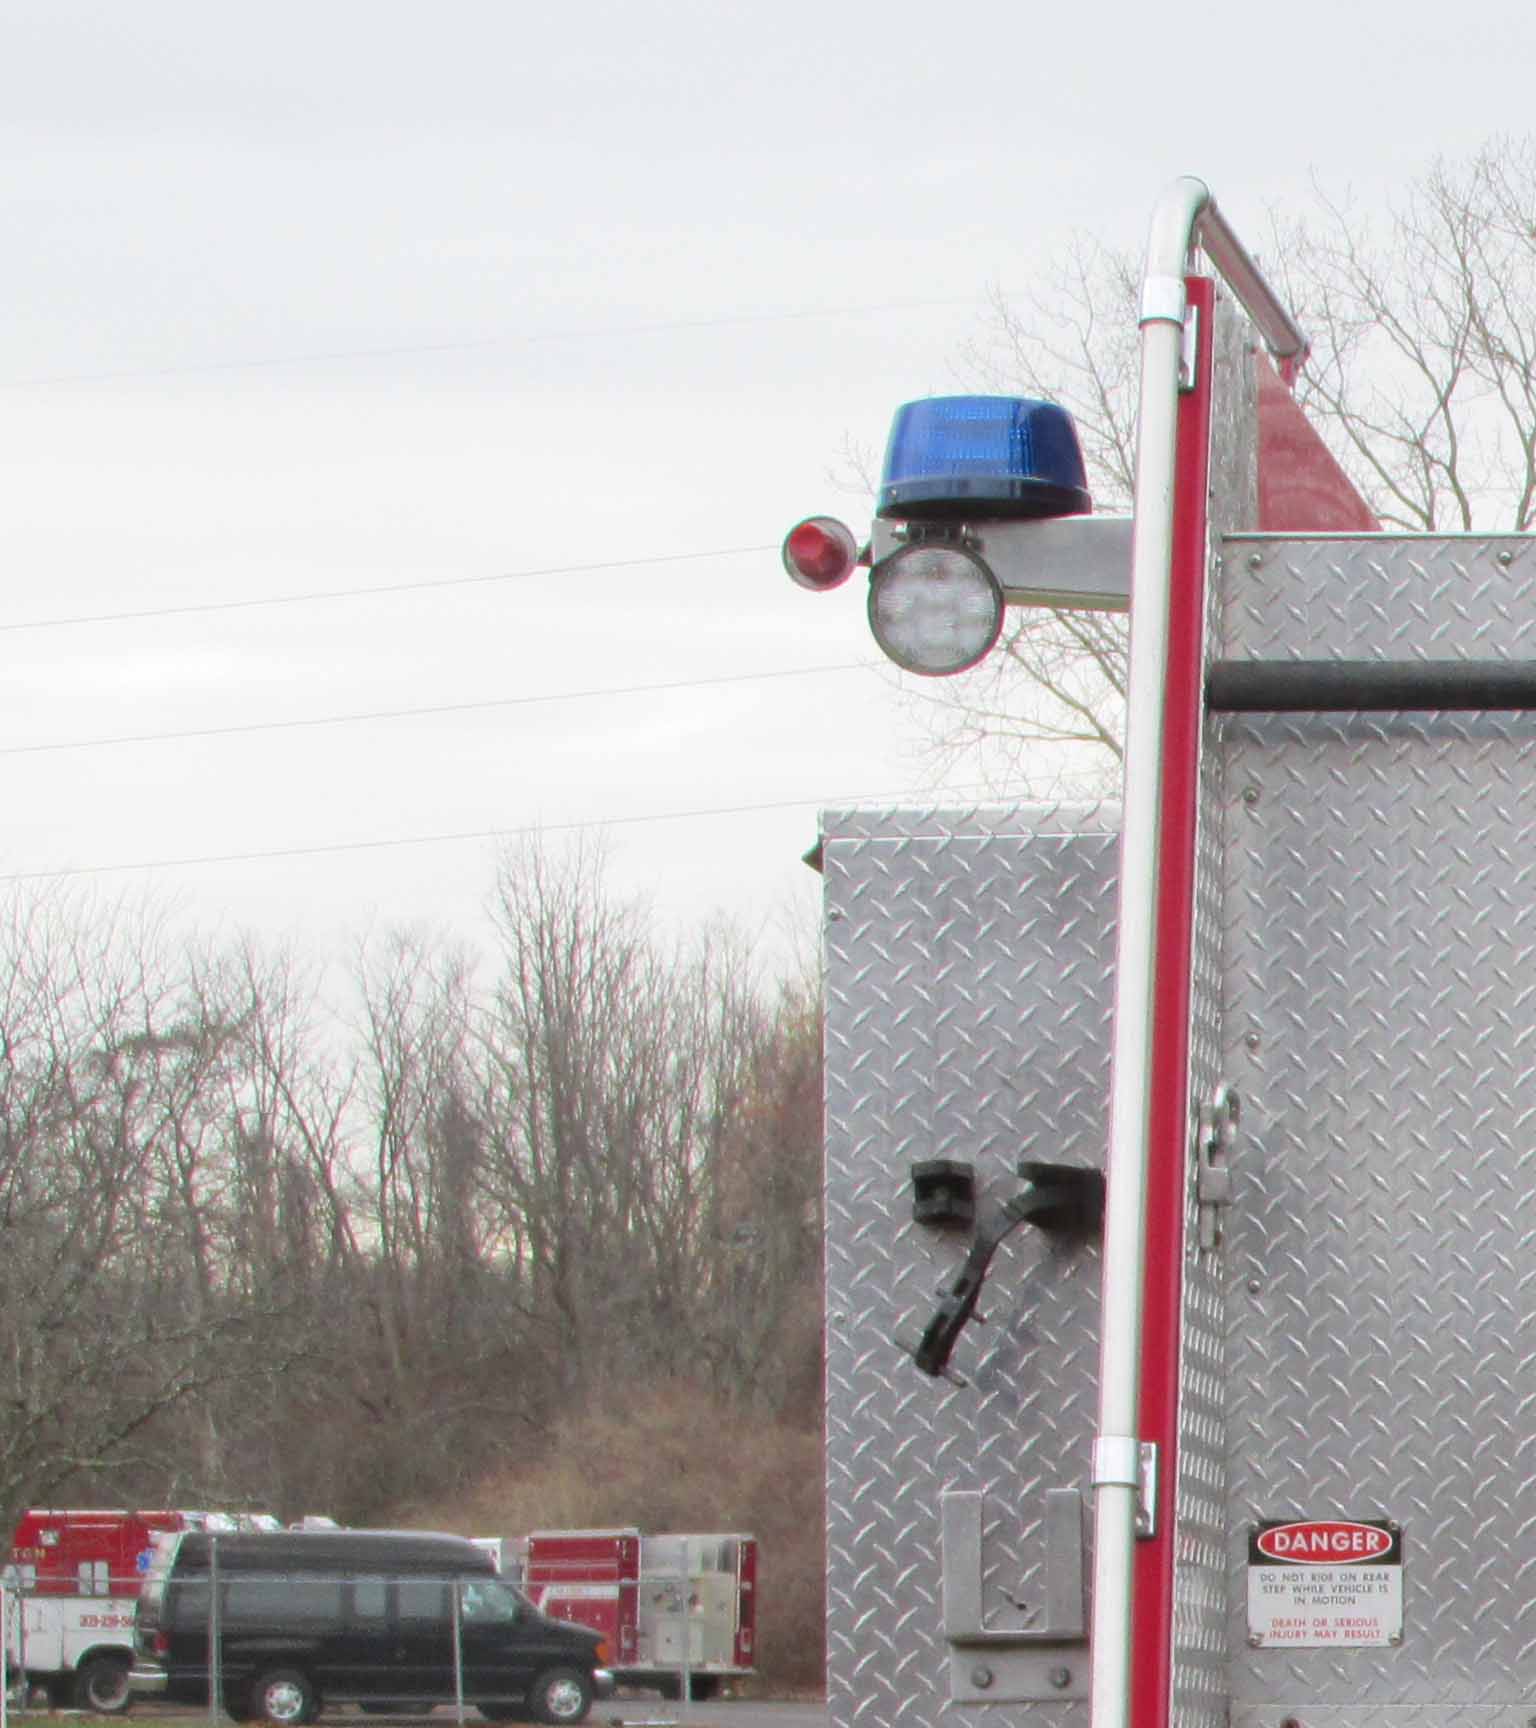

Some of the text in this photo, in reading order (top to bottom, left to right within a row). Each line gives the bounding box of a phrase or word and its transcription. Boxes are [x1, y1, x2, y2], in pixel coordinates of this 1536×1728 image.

[1273, 1531, 1380, 1552] DANGER
[1260, 1573, 1389, 1582] DO NOT RIDE ON REAR
[1263, 1584, 1389, 1593] STEP WHILE VEHICLE IS
[1294, 1596, 1356, 1605] IN MOTION
[1272, 1618, 1378, 1627] DEATH OR SERIOUS
[1269, 1630, 1307, 1639] INJURY
[1314, 1630, 1337, 1639] MAY
